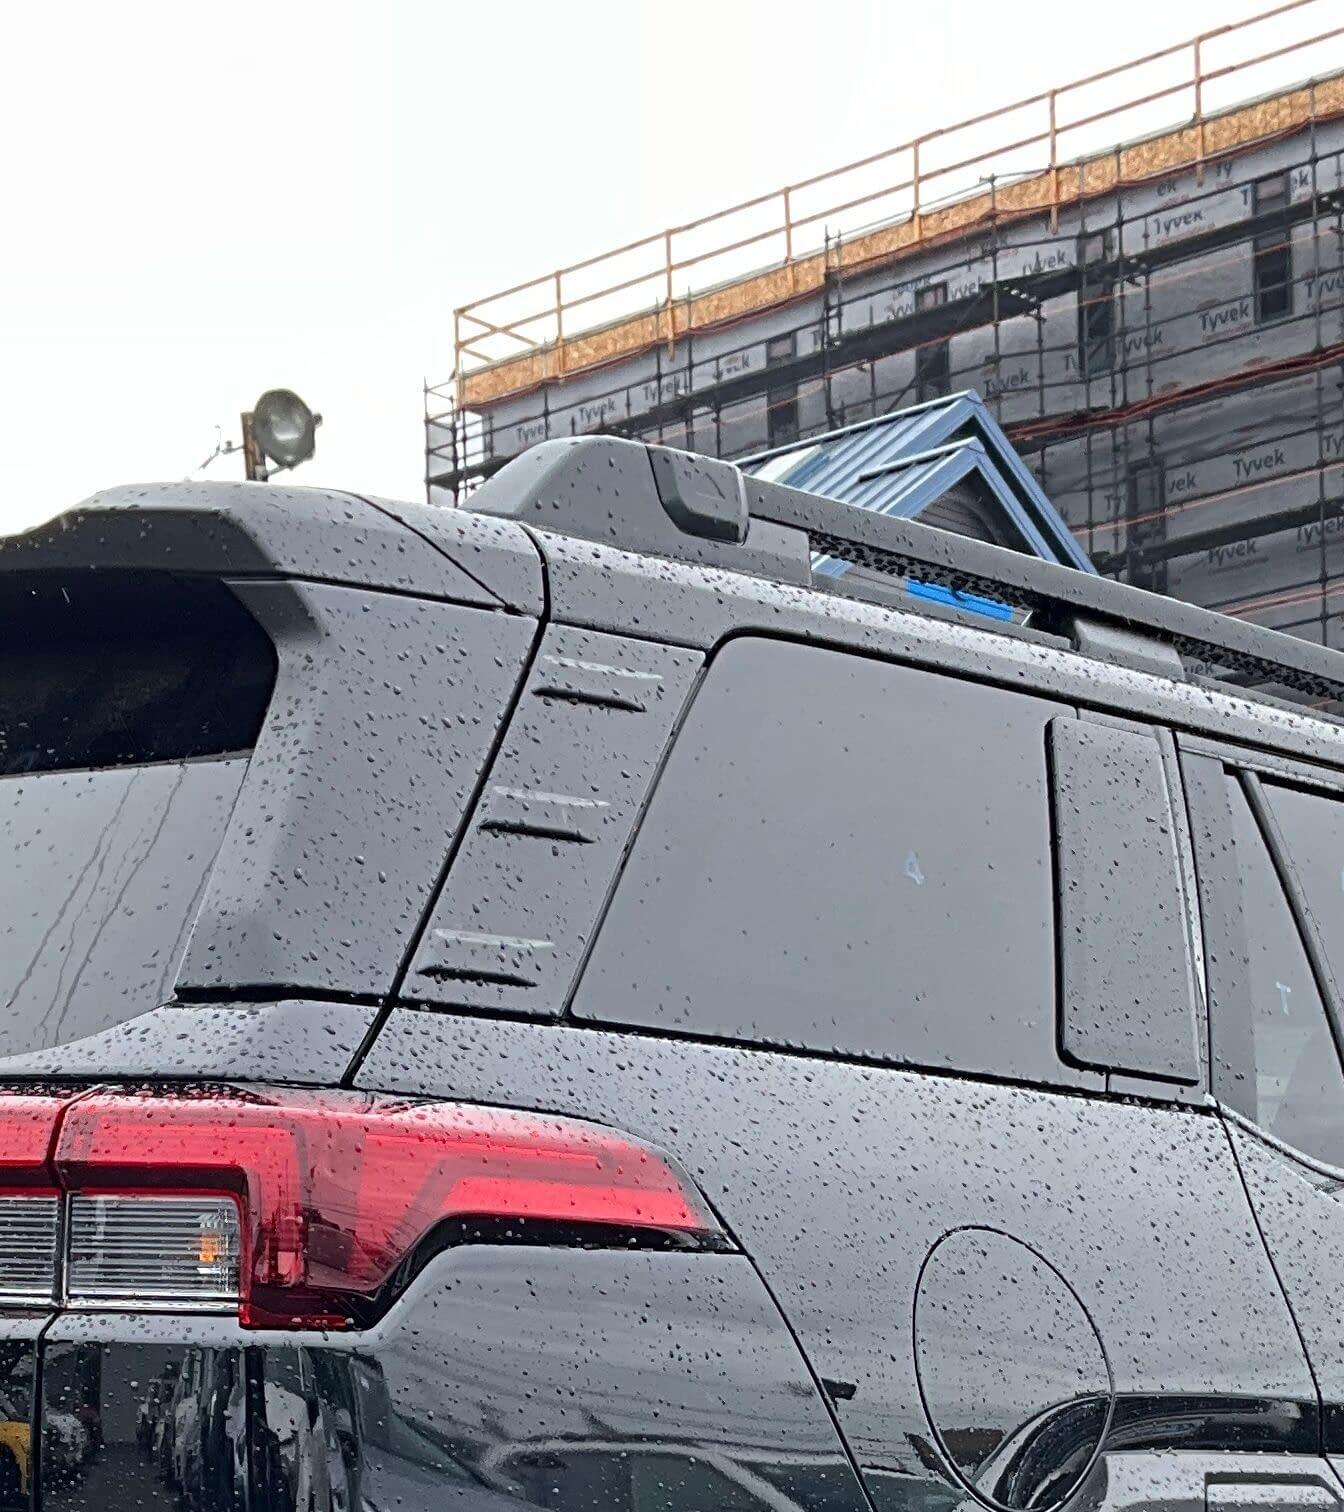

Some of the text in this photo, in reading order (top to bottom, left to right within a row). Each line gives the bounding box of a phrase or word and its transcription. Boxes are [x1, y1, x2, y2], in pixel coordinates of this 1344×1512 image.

[1155, 209, 1203, 235] Tyvek
[1198, 301, 1250, 331] Tyvek
[579, 397, 616, 422] Tyvek
[1233, 450, 1286, 480] Tyvek
[1207, 540, 1257, 567] Tyvek
